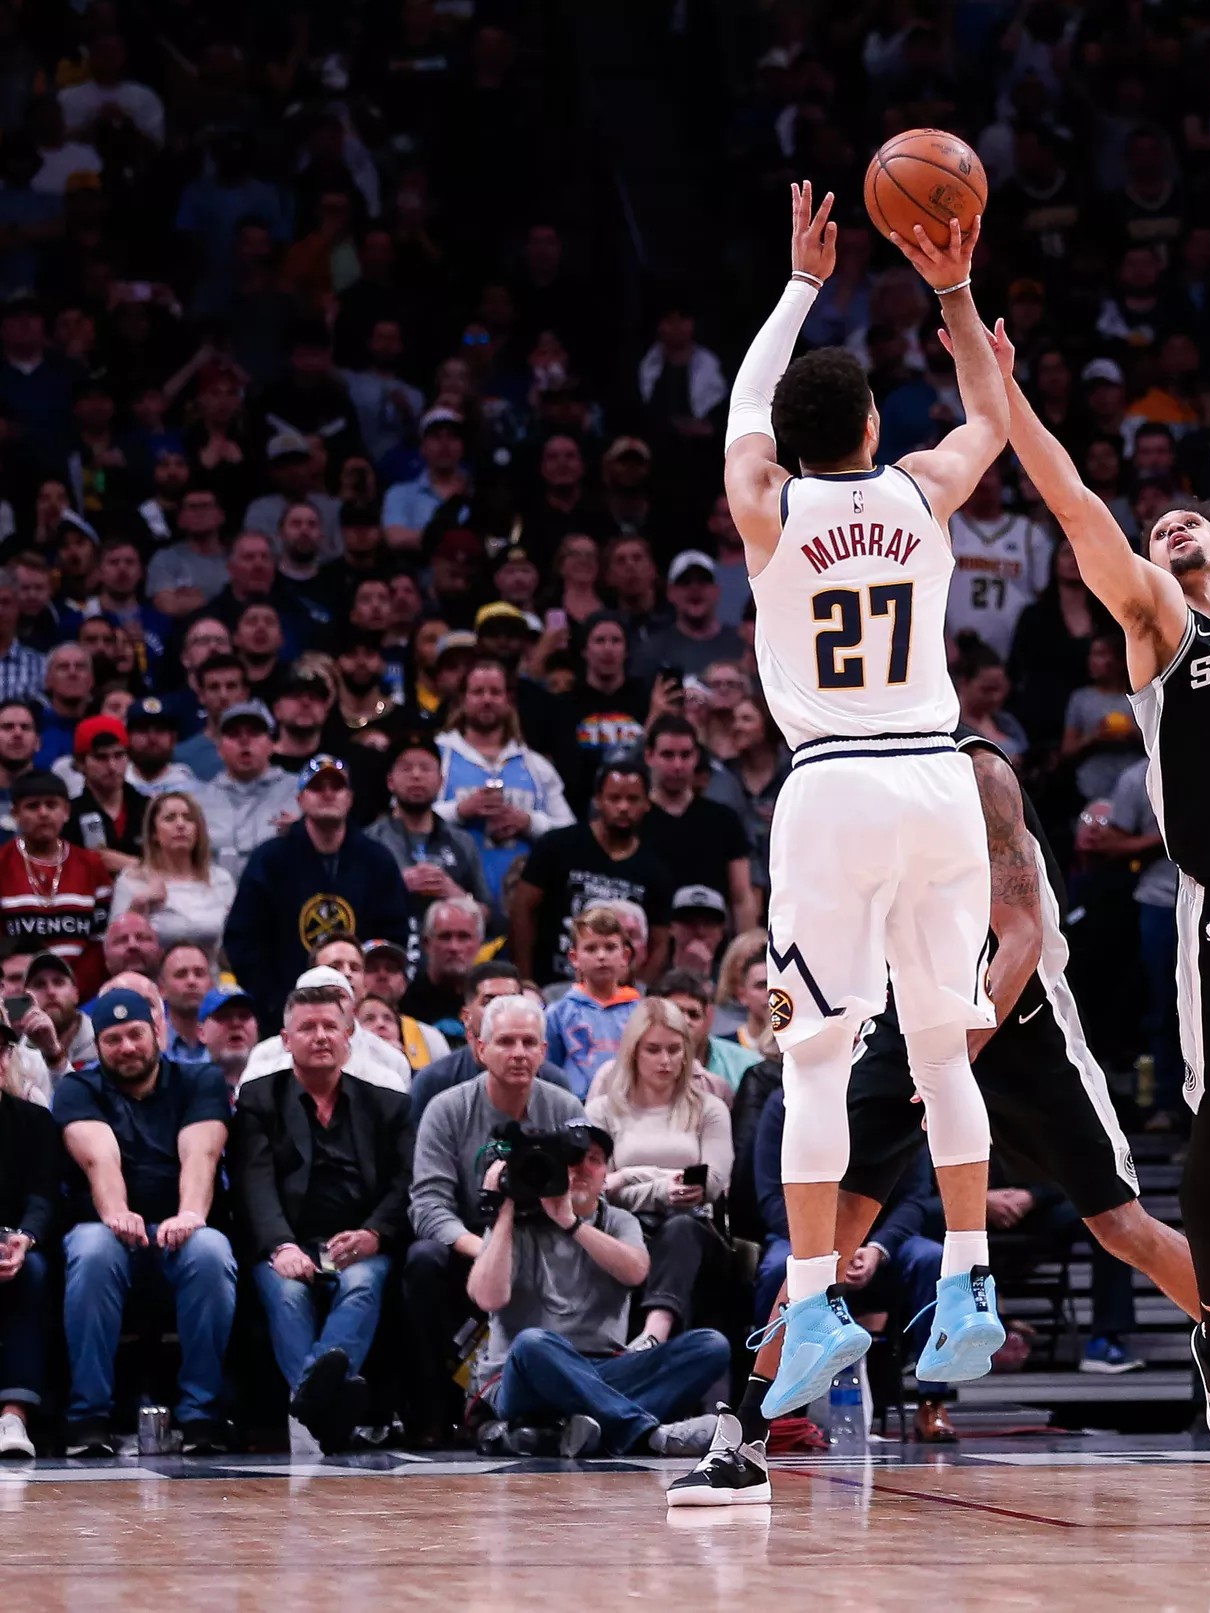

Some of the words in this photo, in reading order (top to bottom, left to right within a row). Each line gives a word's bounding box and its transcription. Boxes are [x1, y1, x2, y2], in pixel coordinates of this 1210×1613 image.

[800, 522, 922, 575] MURRAY
[970, 576, 1006, 610] 27
[810, 580, 915, 692] 27
